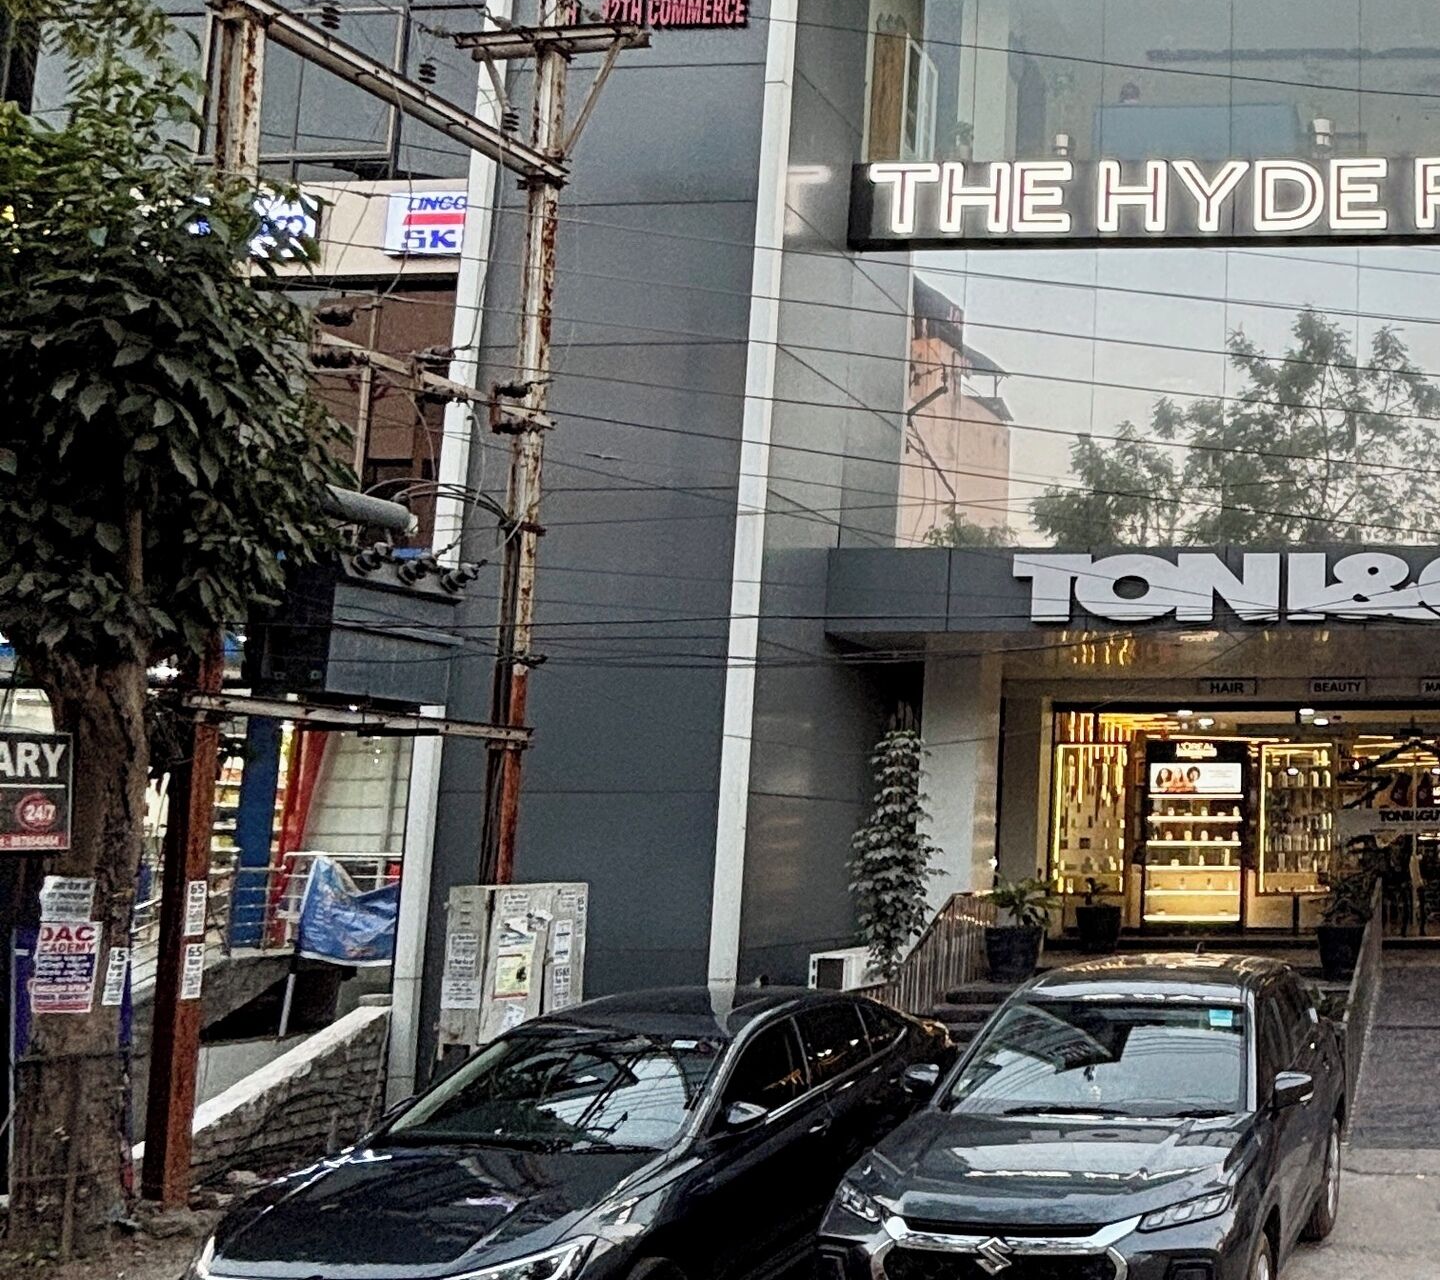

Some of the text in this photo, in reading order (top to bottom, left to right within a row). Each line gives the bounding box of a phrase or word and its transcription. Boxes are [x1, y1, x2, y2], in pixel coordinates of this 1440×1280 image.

[868, 161, 1074, 235] THE
[1096, 157, 1389, 234] HYDE
[1209, 682, 1245, 694] HAIR
[1313, 681, 1362, 693] BEAUTY
